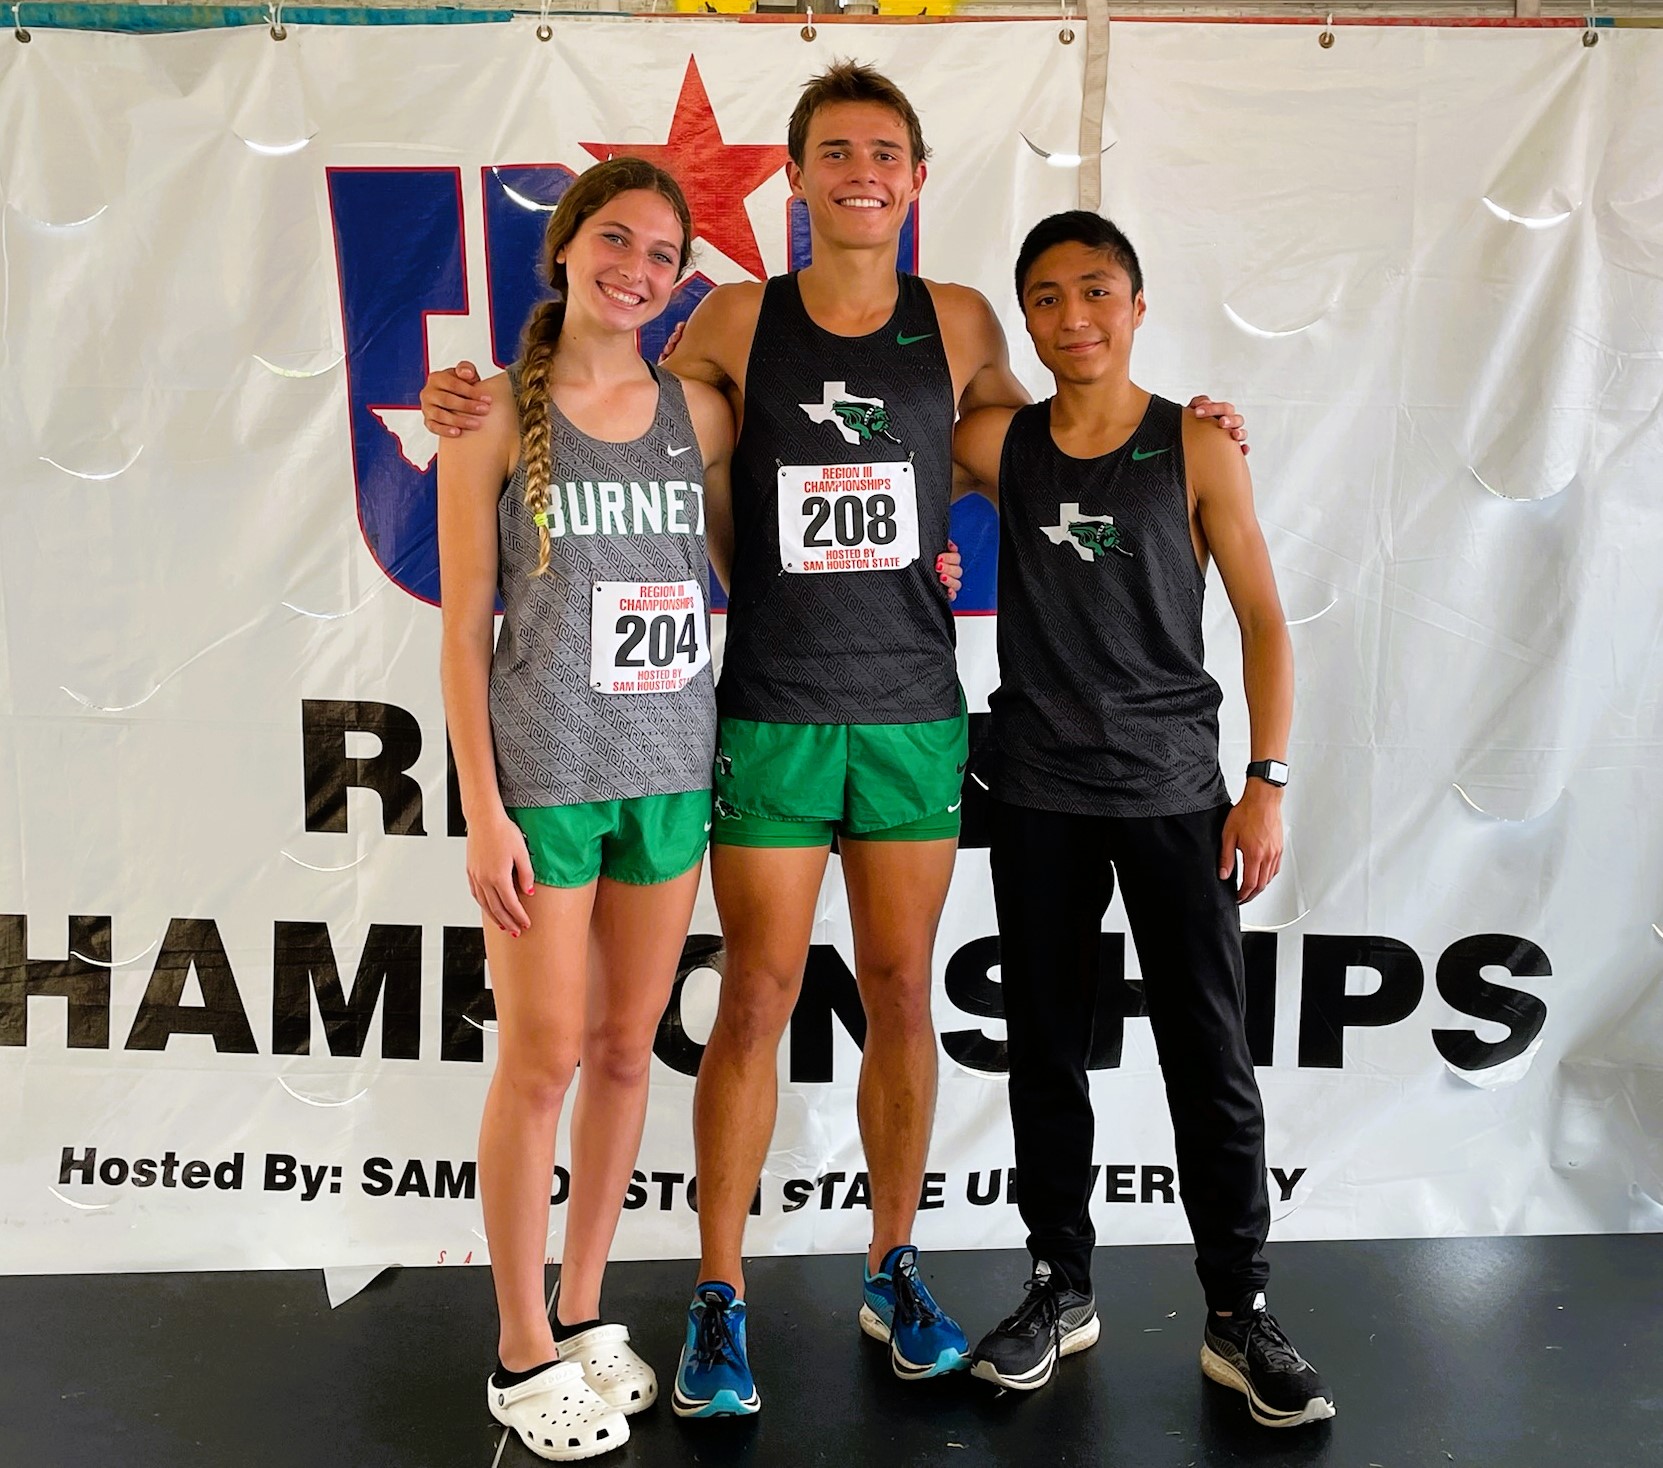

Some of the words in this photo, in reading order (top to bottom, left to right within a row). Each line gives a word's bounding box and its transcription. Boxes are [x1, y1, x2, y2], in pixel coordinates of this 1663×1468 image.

[822, 467, 860, 479] REGION
[863, 466, 873, 478] III
[804, 478, 891, 493] CHAMPIONSHIPS
[802, 494, 897, 547] 208
[826, 549, 861, 560] HOSTED
[863, 548, 876, 558] BY
[803, 561, 824, 571] SAM
[826, 559, 870, 570] HOUSTON
[873, 557, 901, 568] STATE
[640, 585, 676, 598] REGION
[619, 597, 694, 611] CHAMPIONSHIPS
[615, 613, 698, 667] 204
[637, 669, 669, 680] HOSTED
[672, 668, 682, 679] BY
[613, 681, 635, 692] SAM
[637, 680, 676, 691] HOUSTON
[57, 1147, 245, 1190] Hosted
[263, 1153, 343, 1202] By:
[361, 1156, 476, 1200] SAM
[782, 1172, 946, 1213] STAE
